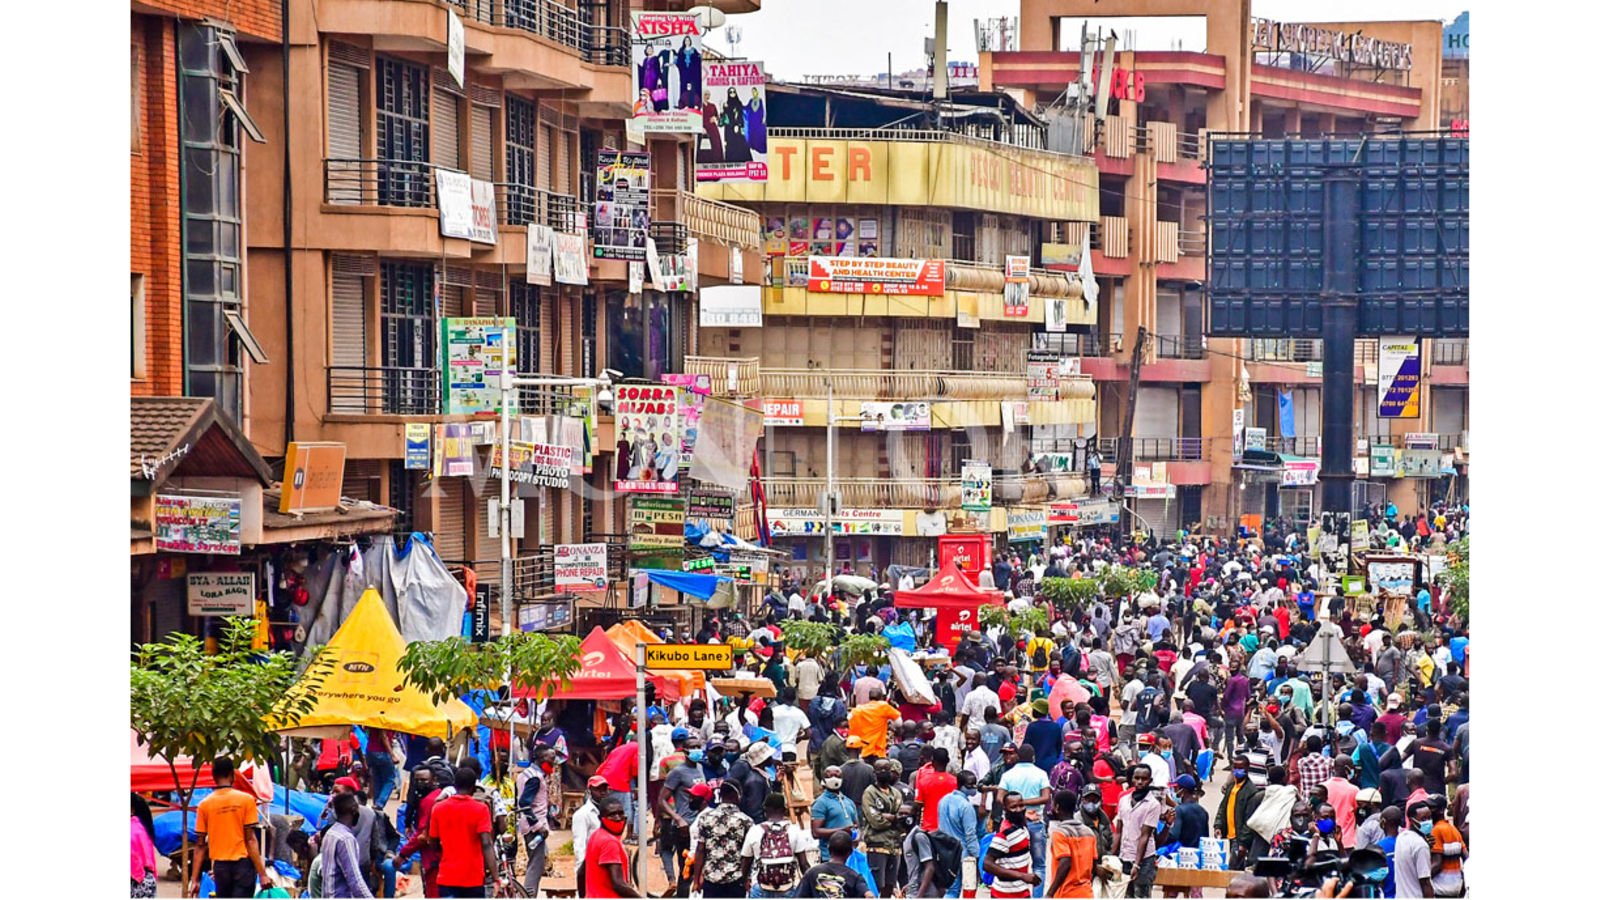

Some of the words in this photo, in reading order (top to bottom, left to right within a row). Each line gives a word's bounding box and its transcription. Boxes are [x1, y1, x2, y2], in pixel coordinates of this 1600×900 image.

[636, 22, 700, 35] AISHA
[709, 64, 760, 77] TAHIYA
[886, 262, 919, 270] BEAUTY
[833, 268, 851, 276] AND
[851, 269, 884, 277] HEALTH
[885, 269, 917, 278] CENTER
[618, 387, 675, 400] SOKRA
[618, 402, 675, 415] HIJABS
[534, 444, 571, 458] PLASTIC
[491, 468, 533, 483] PHOCOPY
[536, 464, 569, 478] PHOTO
[533, 476, 569, 489] STUDIO
[783, 509, 821, 518] GERMAN
[852, 509, 882, 518] Centre
[639, 536, 662, 544] Family
[197, 541, 239, 553] Services
[557, 546, 605, 557] BONANZA
[556, 568, 578, 577] PHONE
[580, 567, 605, 577] REPAIR
[216, 575, 251, 586] ALLAH
[950, 622, 972, 632] airtel
[648, 651, 689, 662] Kikubo
[694, 651, 722, 662] Lane
[348, 663, 370, 672] MTN
[387, 697, 401, 705] go
